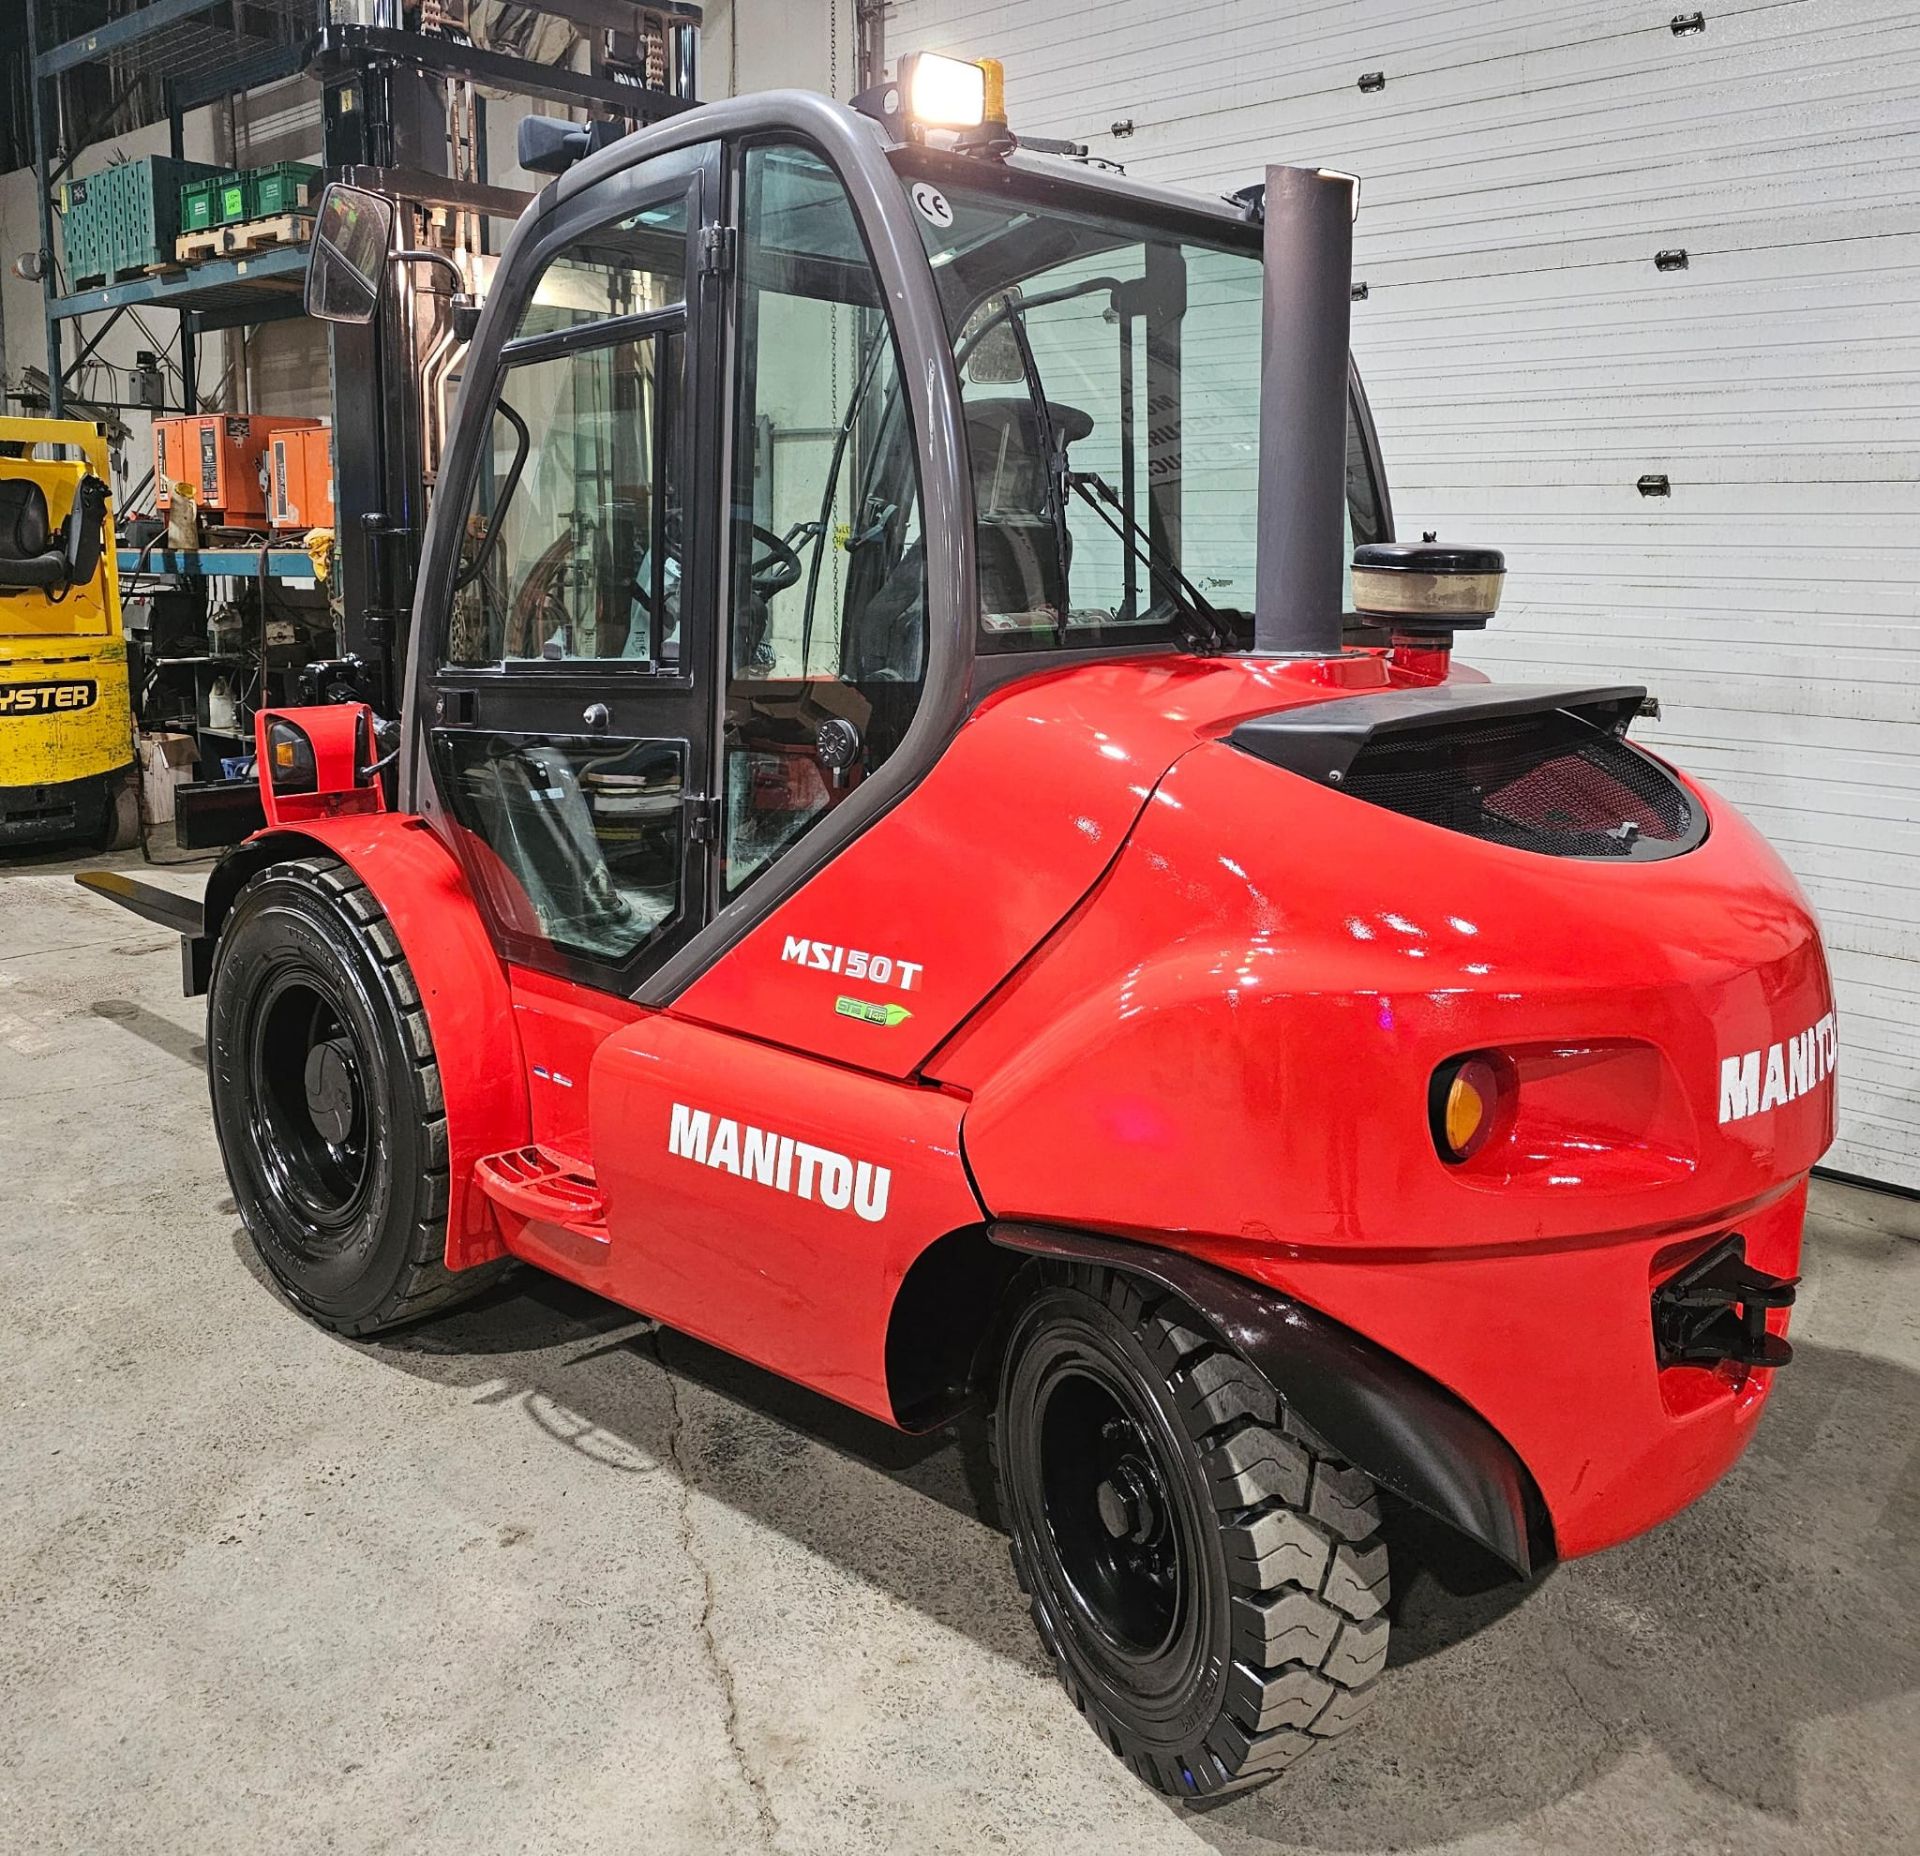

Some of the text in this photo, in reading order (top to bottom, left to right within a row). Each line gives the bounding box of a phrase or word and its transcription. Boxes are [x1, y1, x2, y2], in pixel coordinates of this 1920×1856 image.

[917, 192, 949, 219] CE
[1719, 1011, 1838, 1124] MANITO
[668, 1102, 891, 1222] MANITOU
